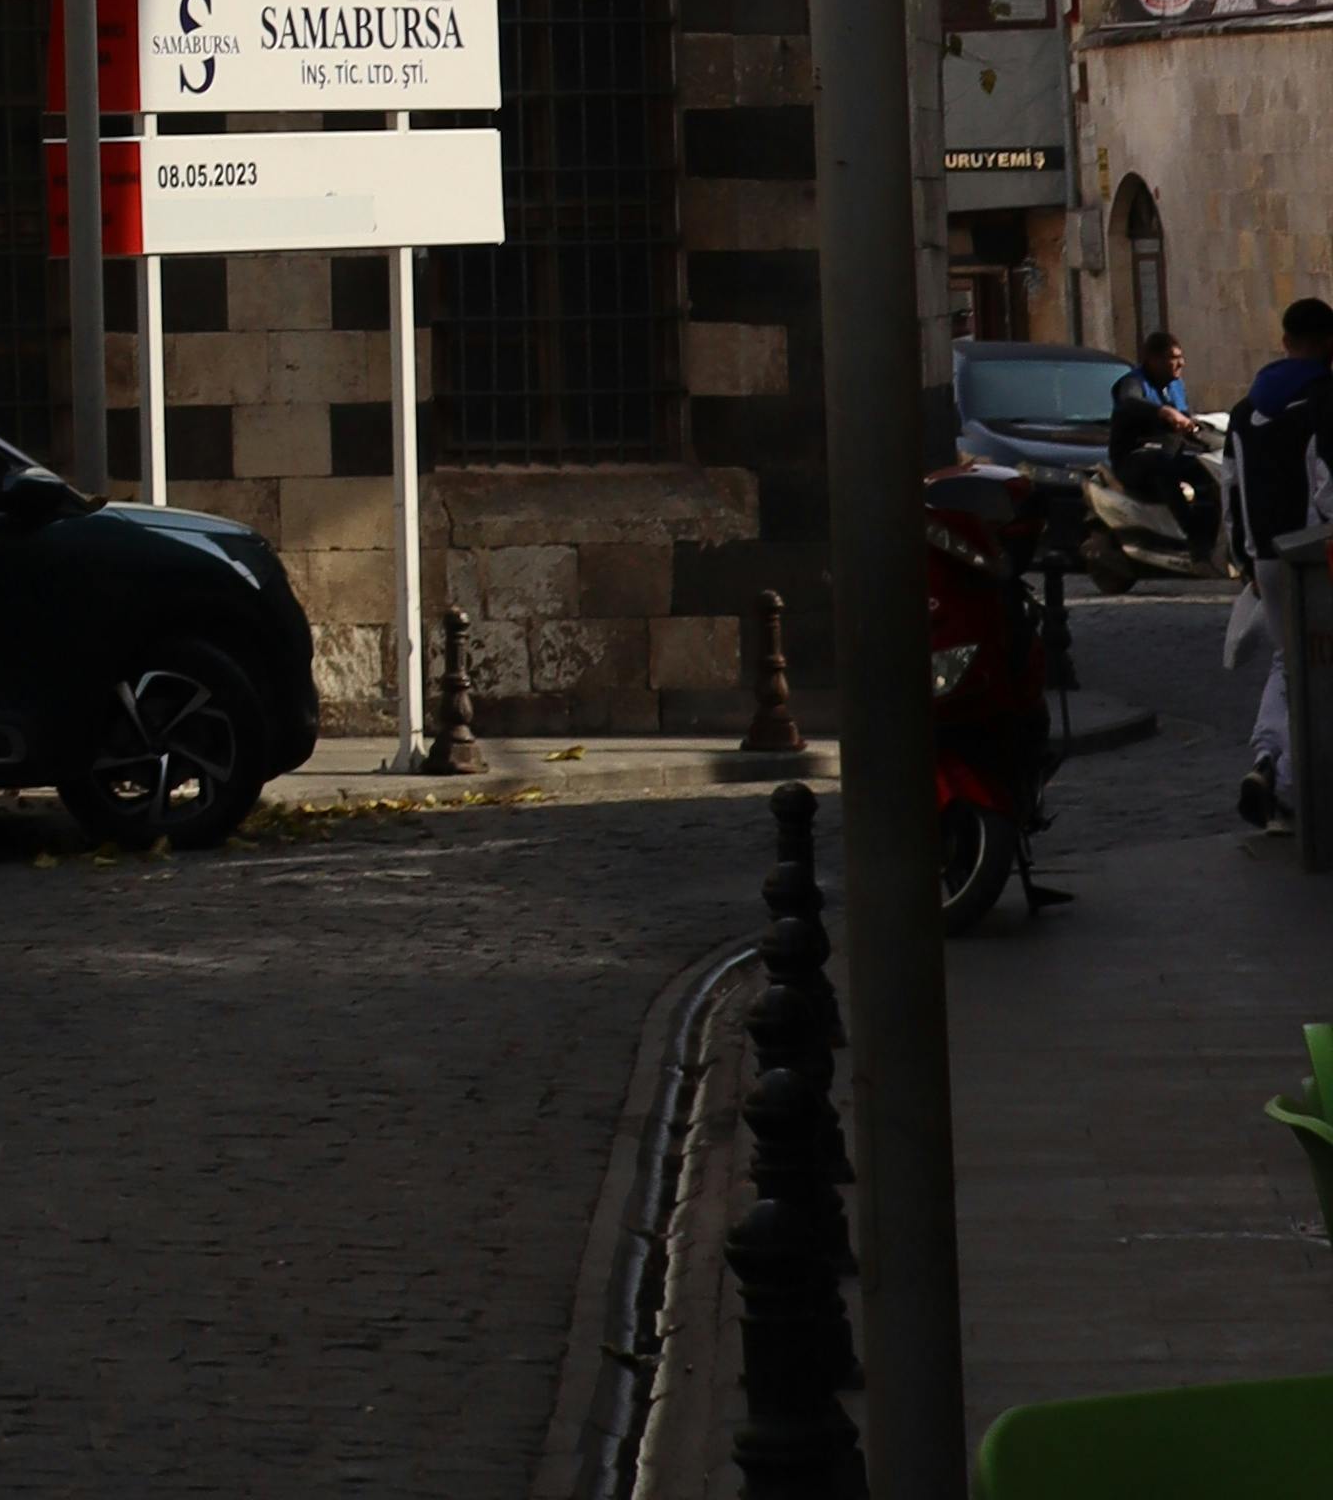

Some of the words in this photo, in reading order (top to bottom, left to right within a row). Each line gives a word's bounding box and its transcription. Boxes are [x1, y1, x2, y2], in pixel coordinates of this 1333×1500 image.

[153, 35, 240, 55] SAMABURSA
[261, 6, 465, 50] SAMABURSA
[300, 58, 331, 89] İNŞ.
[334, 59, 363, 84] TİC.
[367, 63, 397, 85] LTD.
[402, 58, 428, 89] ŞTİ.
[944, 148, 1046, 171] URUYEMİŞ
[157, 161, 258, 188] 08.05.2023
